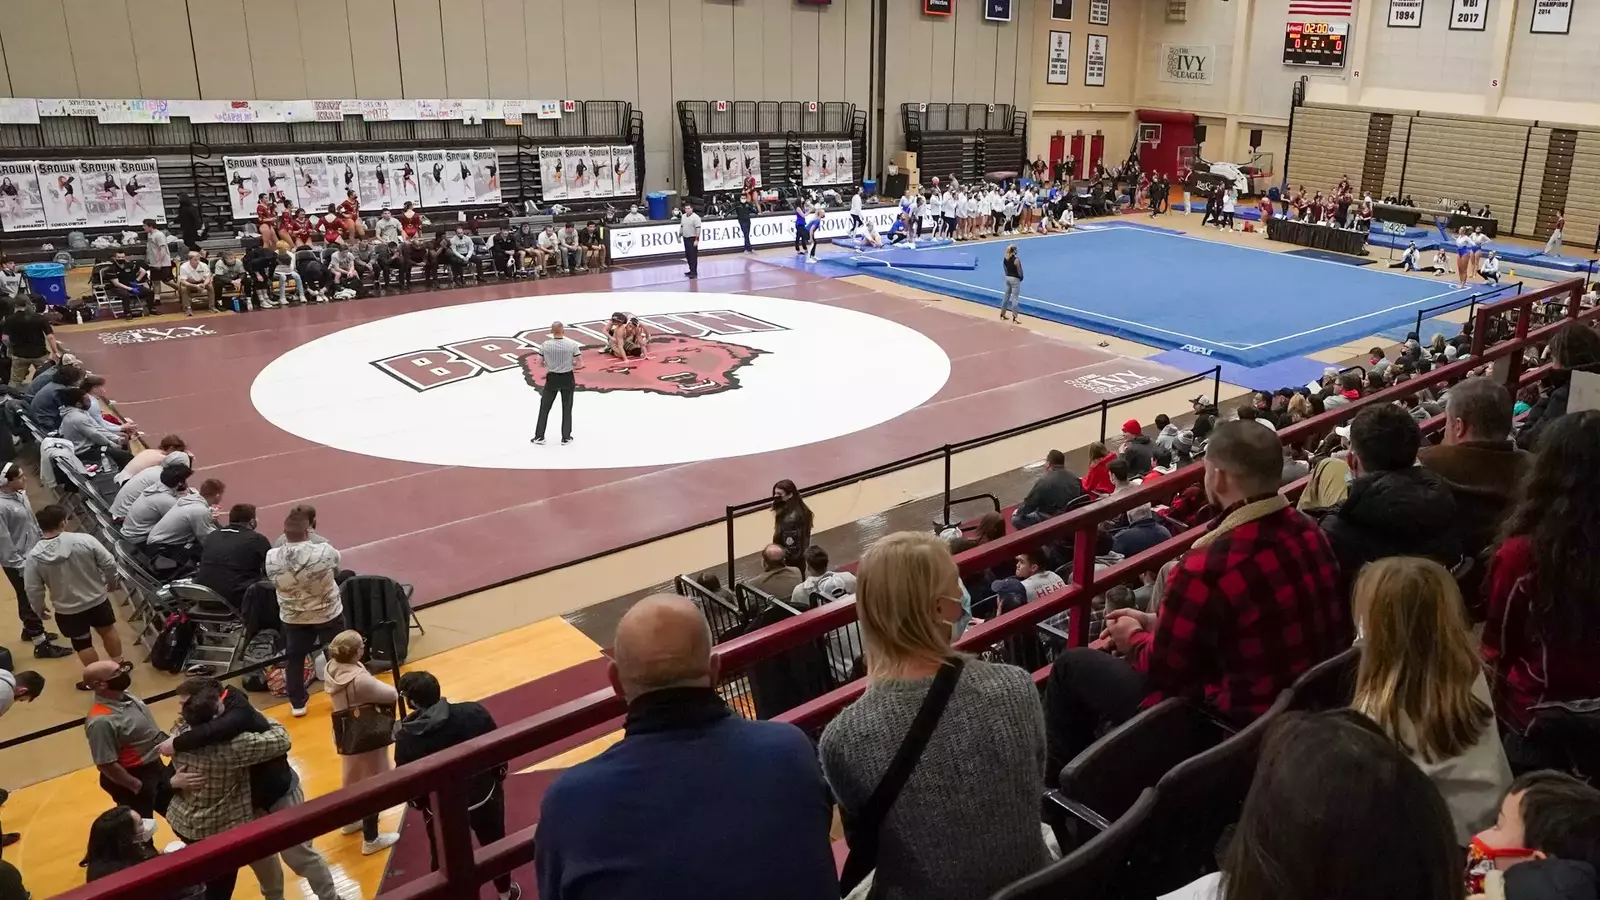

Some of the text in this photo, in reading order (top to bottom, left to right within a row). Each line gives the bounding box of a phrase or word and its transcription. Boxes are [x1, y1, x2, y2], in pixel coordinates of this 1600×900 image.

[1396, 11, 1415, 20] 1994
[1457, 13, 1479, 23] 2017
[1305, 23, 1327, 33] 02:00
[1177, 55, 1206, 71] IVY
[1176, 71, 1207, 80] LEAGUE
[566, 101, 574, 110] M
[719, 102, 725, 110] N
[1089, 370, 1147, 388] IVY
